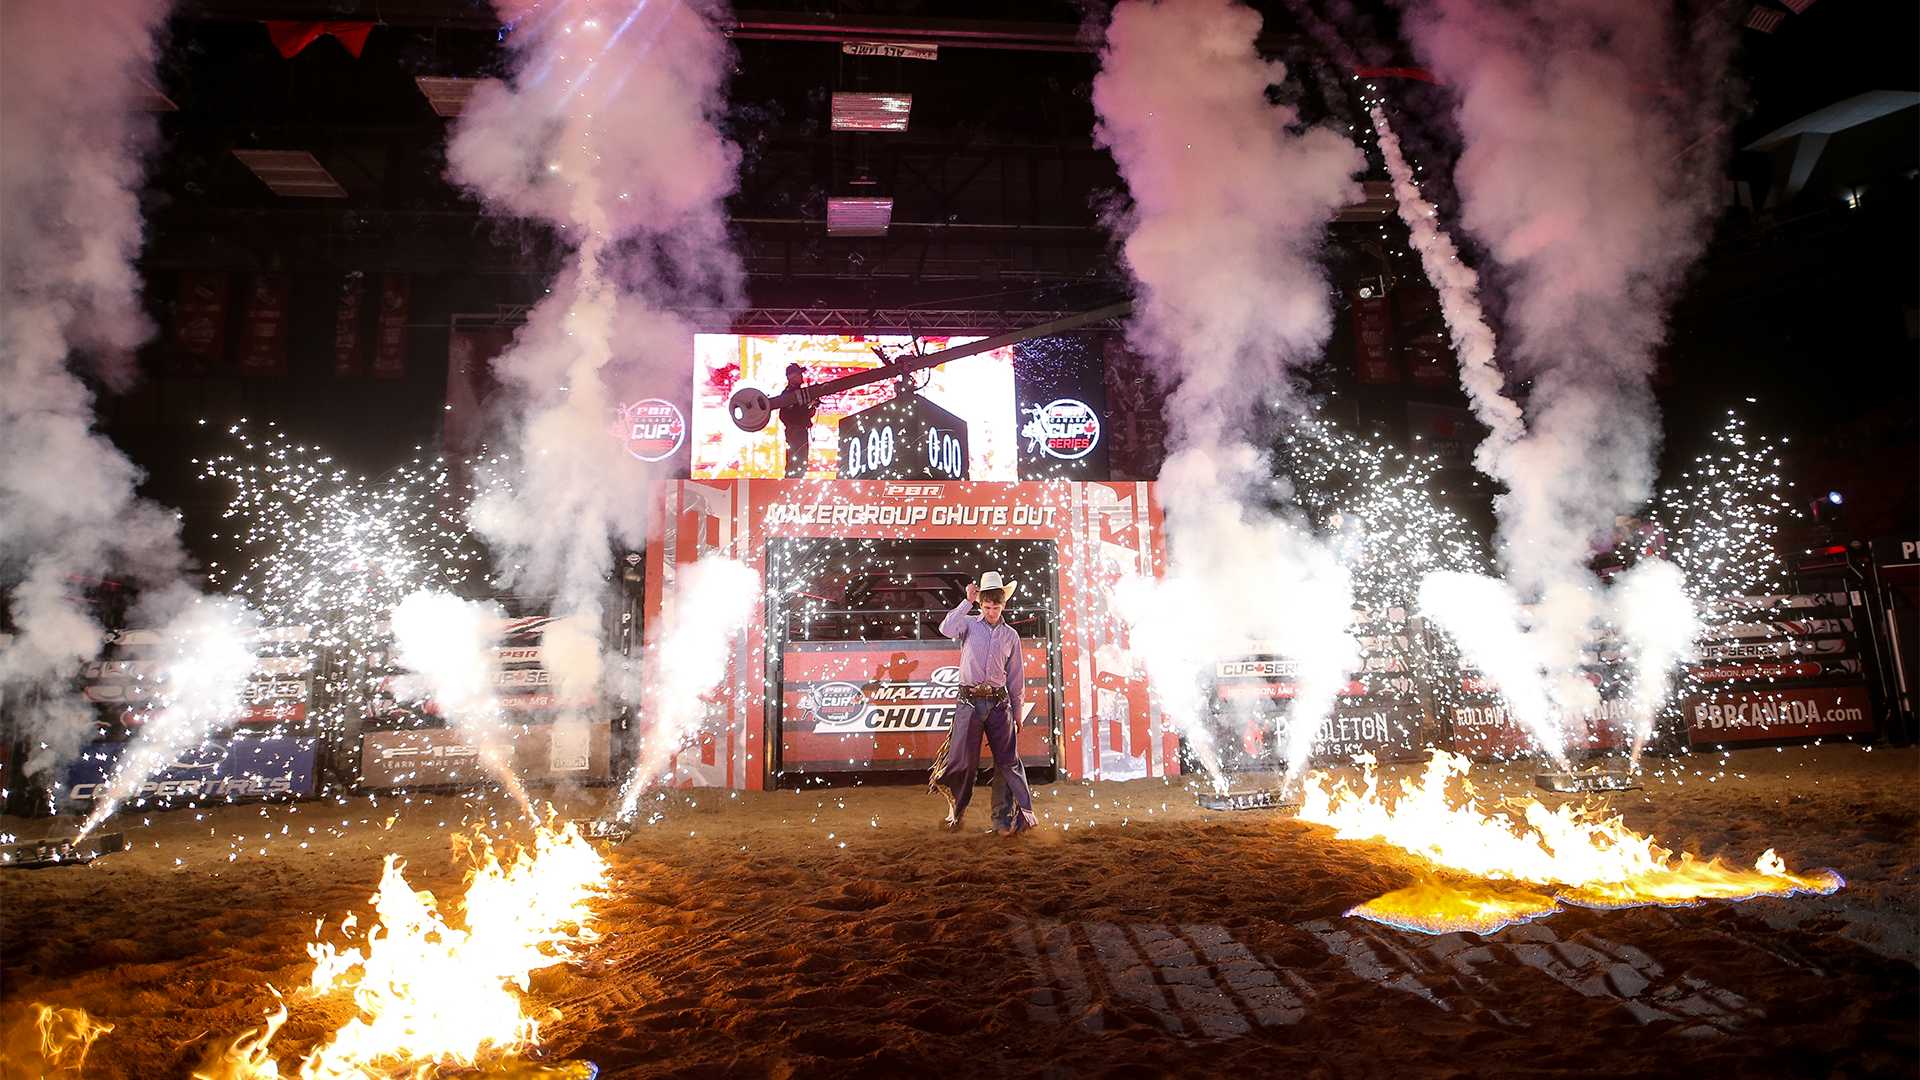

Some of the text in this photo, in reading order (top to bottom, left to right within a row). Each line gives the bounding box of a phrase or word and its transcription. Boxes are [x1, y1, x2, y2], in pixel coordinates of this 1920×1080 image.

[631, 423, 671, 440] CUP
[1046, 424, 1084, 438] CUP
[848, 426, 894, 477] 0.00
[1048, 438, 1089, 449] SERIES
[928, 427, 962, 478] 0.00
[886, 486, 940, 496] PBR
[764, 504, 1057, 527] MAZERGROUP CHUTE OUT
[1223, 663, 1254, 675] CUP
[874, 686, 959, 701] MAZERG
[865, 708, 954, 729] CHUTE
[1694, 700, 1863, 729] PBRCANADA.com
